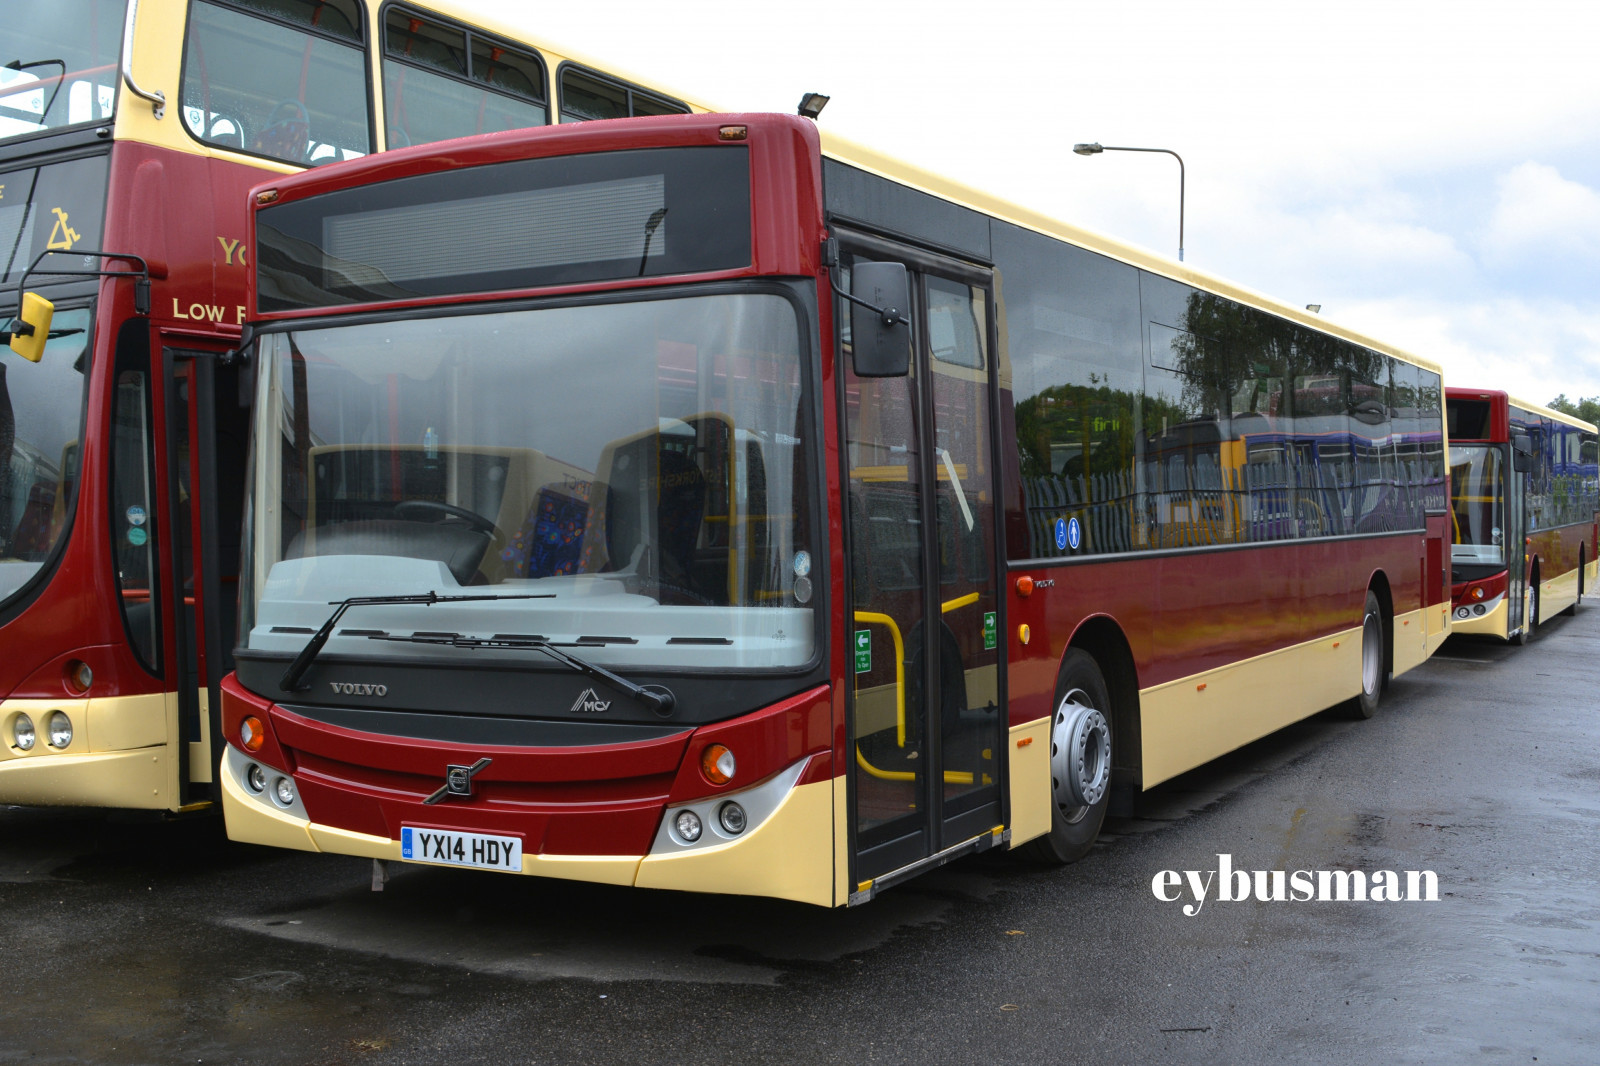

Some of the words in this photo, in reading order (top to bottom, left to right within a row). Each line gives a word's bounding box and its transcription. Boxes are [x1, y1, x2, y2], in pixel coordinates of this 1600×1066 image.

[330, 682, 388, 697] VOLVO
[584, 701, 611, 711] MCV
[419, 833, 465, 861] YX14
[472, 838, 514, 866] HDY
